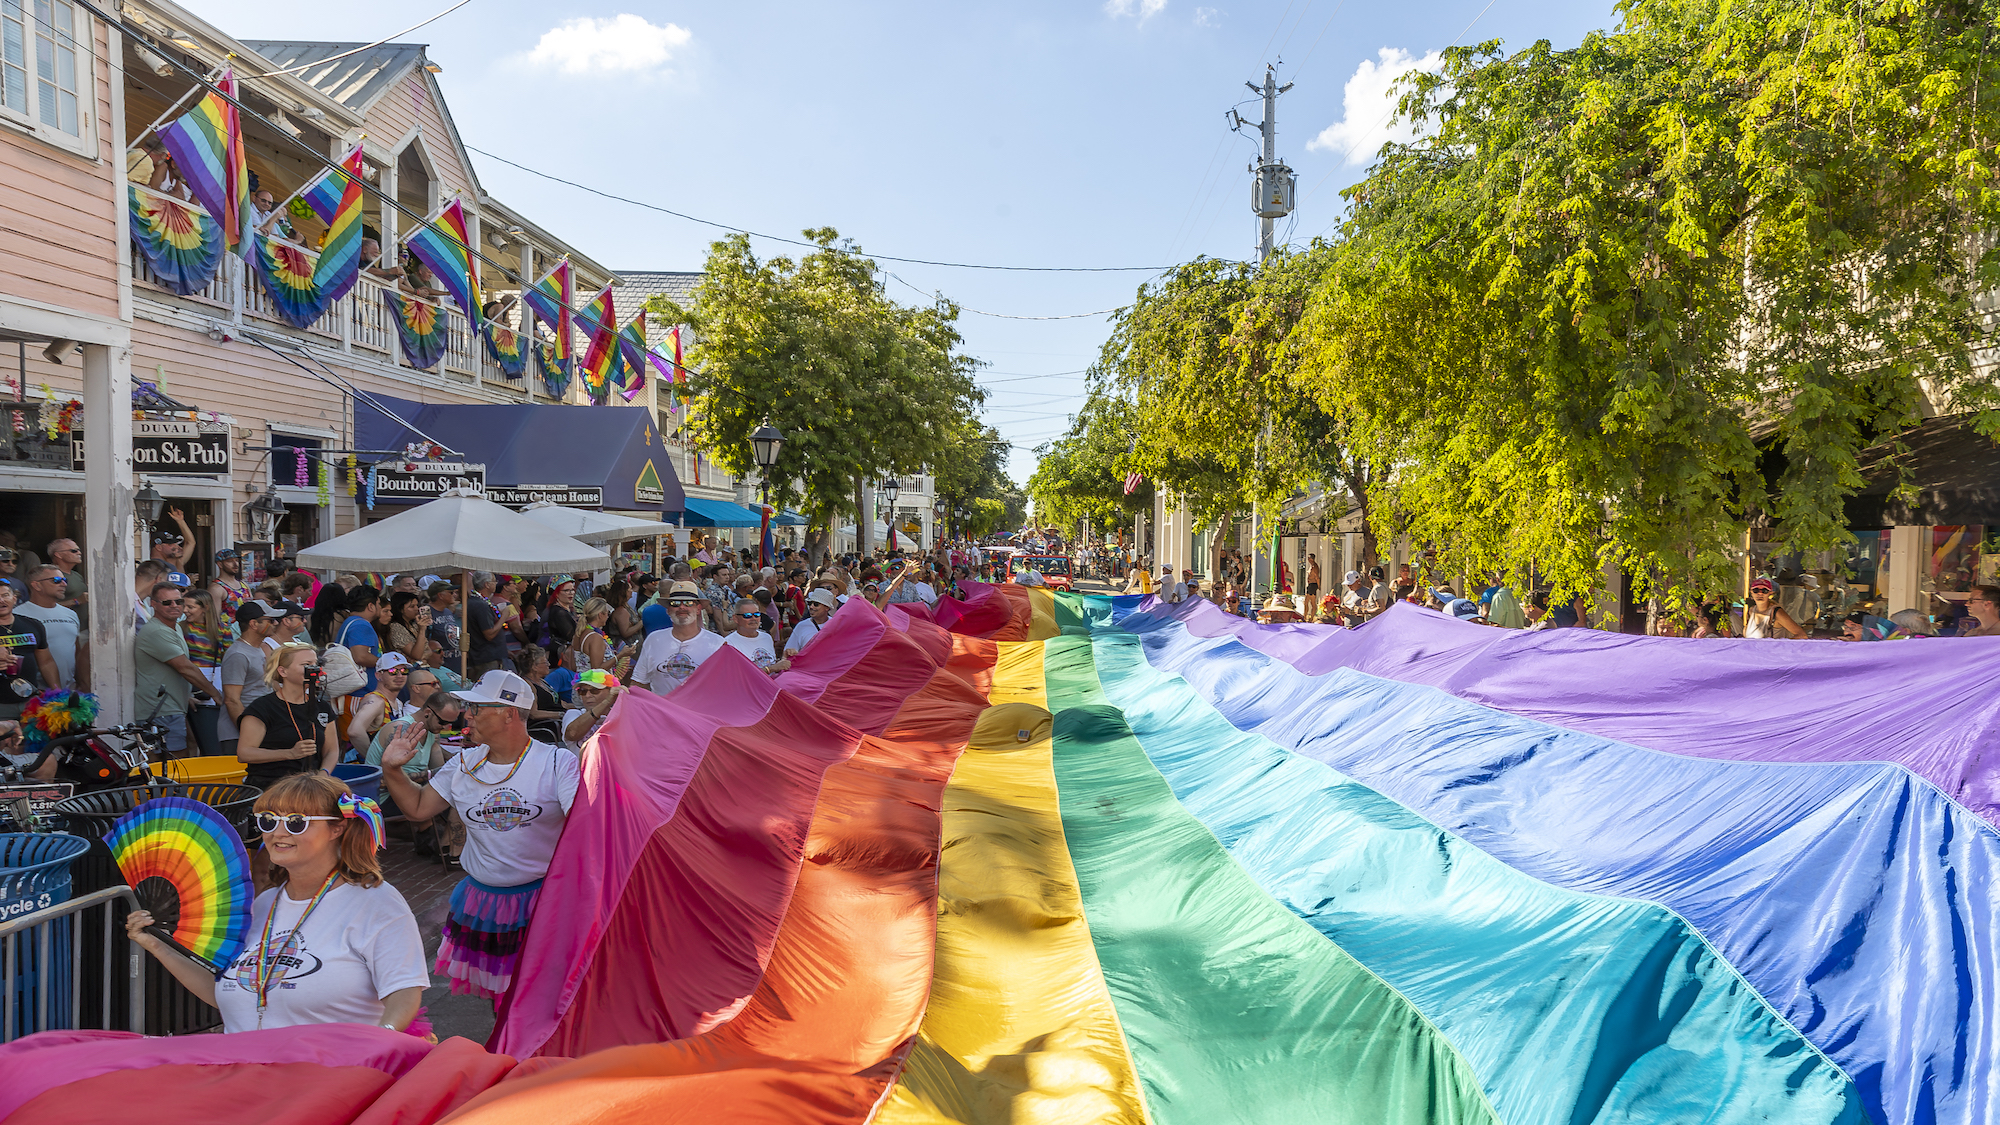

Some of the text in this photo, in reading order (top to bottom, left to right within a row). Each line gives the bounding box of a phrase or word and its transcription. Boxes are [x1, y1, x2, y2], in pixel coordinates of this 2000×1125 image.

[141, 424, 190, 433] DUVAL
[187, 442, 227, 465] Pub
[377, 474, 436, 492] Bourbon
[486, 491, 505, 501] The
[507, 491, 528, 502] New
[568, 491, 599, 502] House
[231, 955, 303, 969] VOLNTEER
